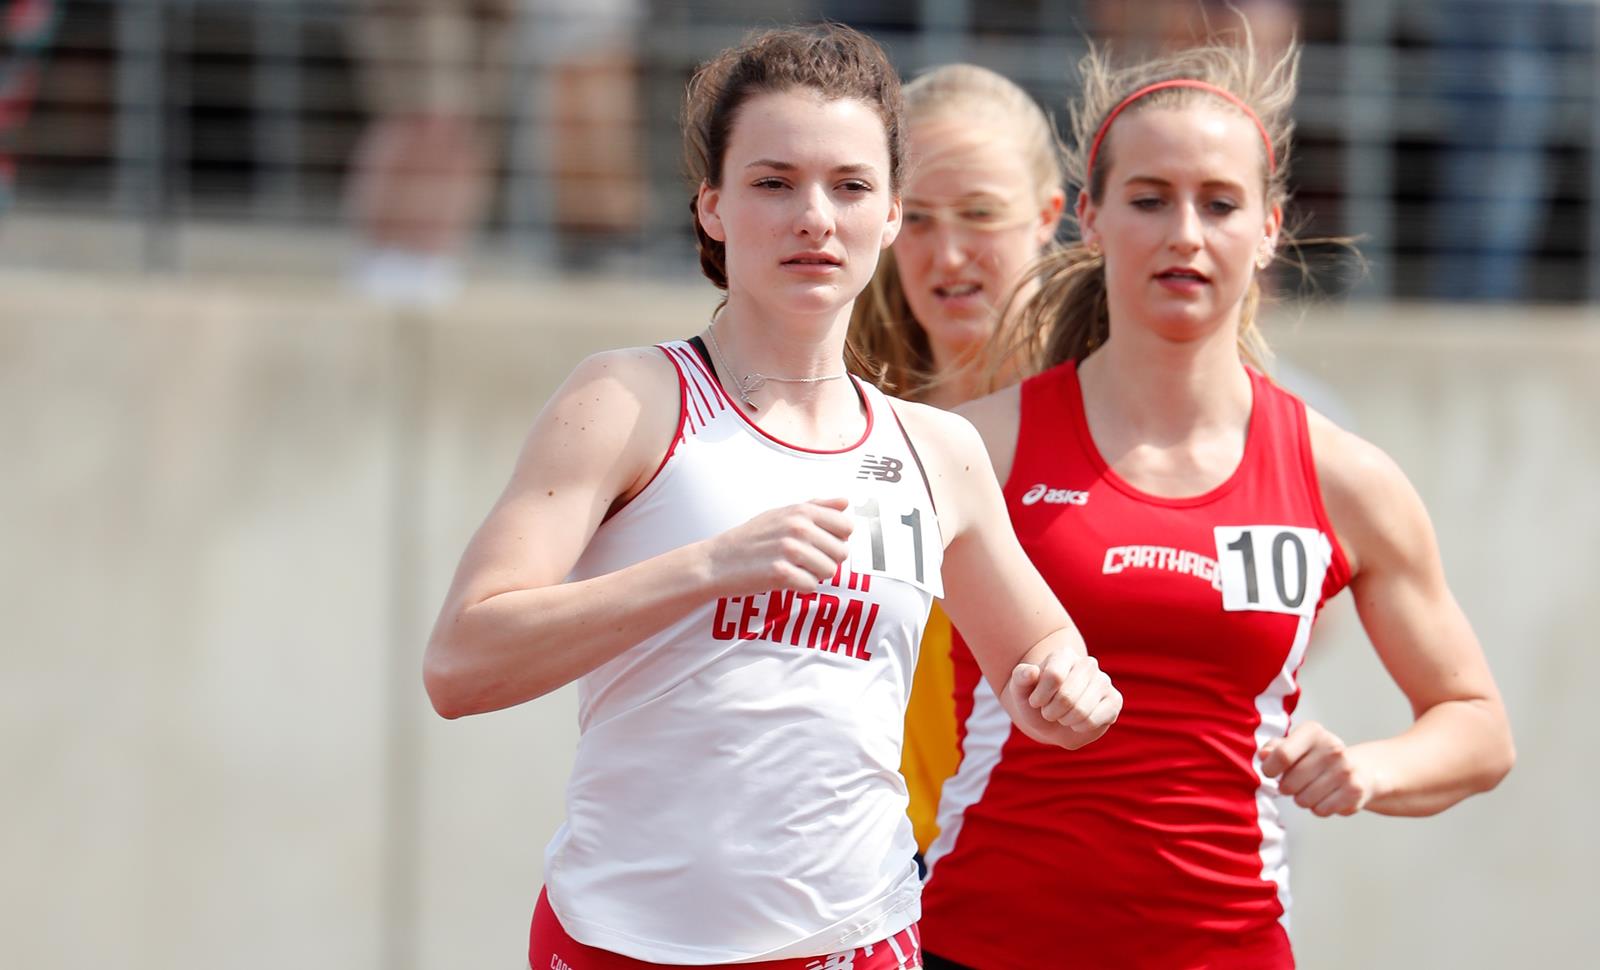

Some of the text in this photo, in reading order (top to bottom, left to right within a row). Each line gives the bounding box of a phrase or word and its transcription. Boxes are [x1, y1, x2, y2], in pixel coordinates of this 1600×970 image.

[1043, 485, 1089, 506] asics
[854, 499, 924, 584] 11
[1227, 530, 1307, 608] 10
[712, 588, 879, 661] CENTRAL
